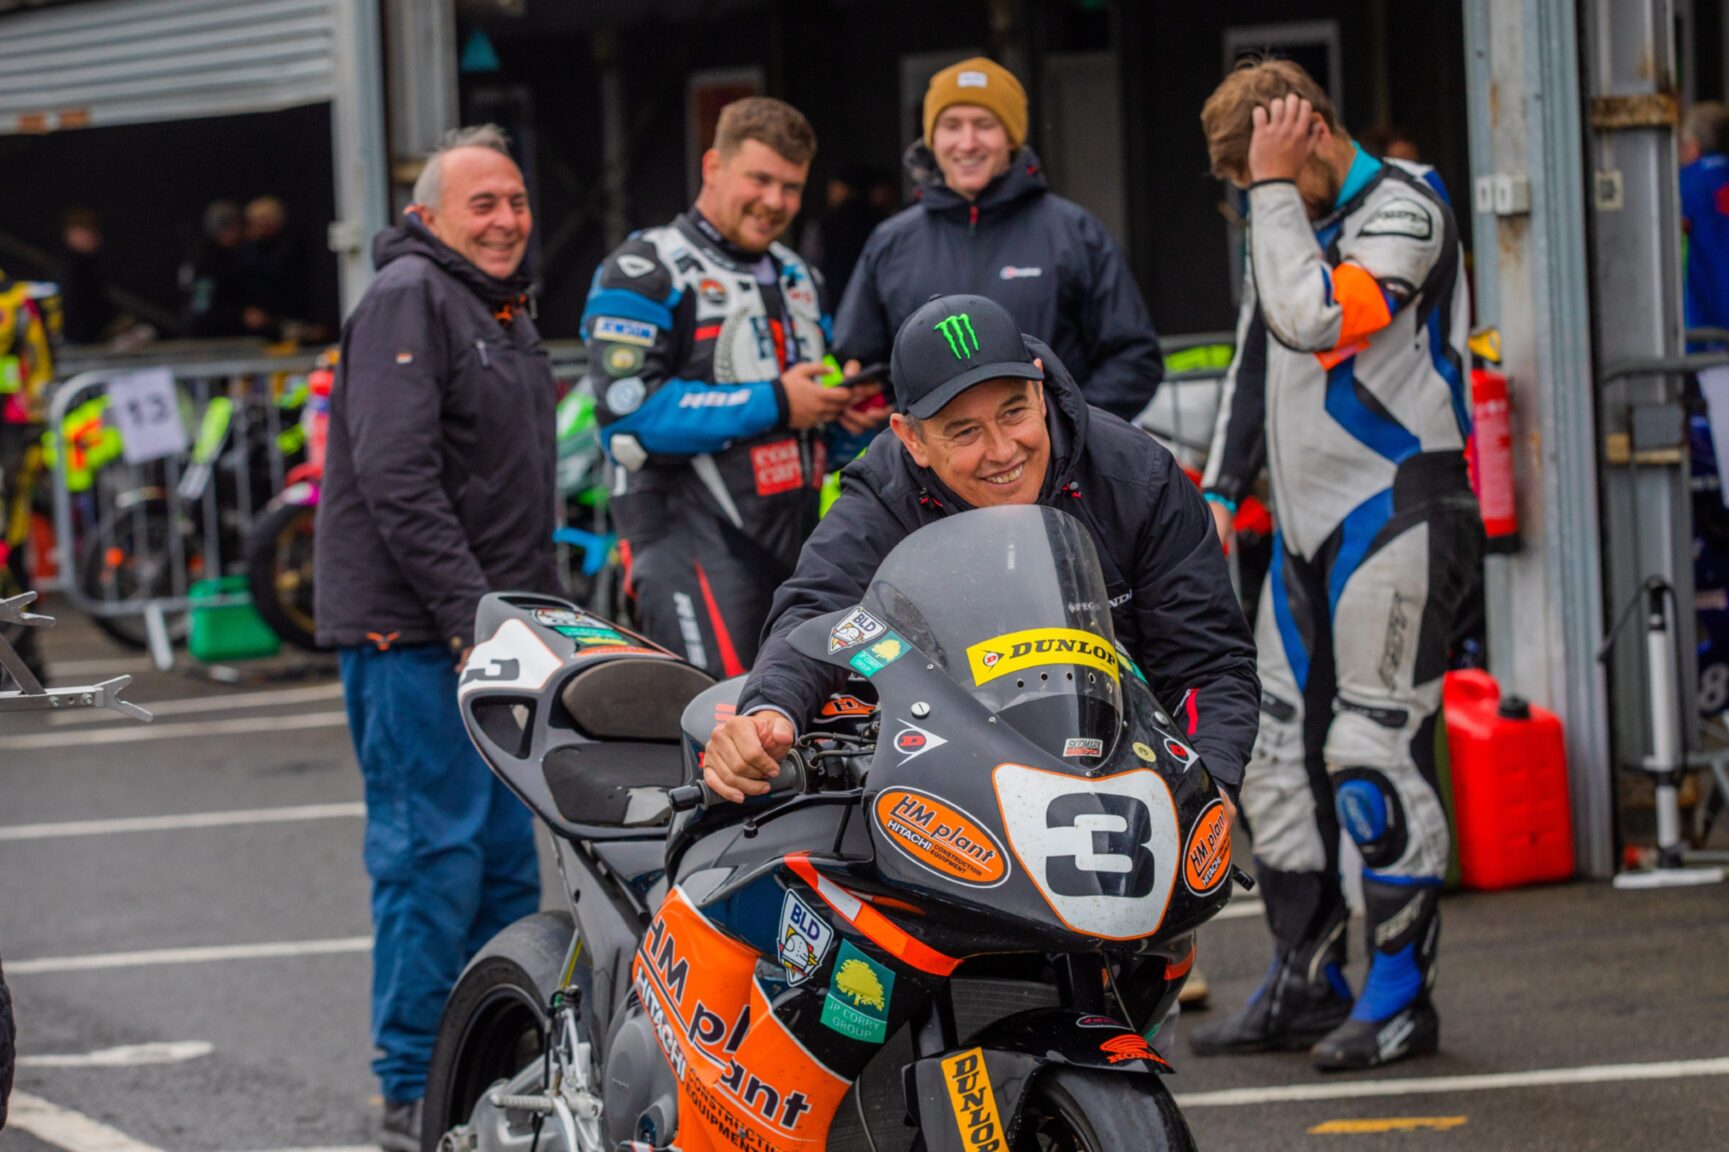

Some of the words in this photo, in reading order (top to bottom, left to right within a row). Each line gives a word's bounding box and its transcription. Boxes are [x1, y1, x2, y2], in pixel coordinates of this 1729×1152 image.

[852, 612, 876, 632] BLD
[1009, 639, 1116, 666] DUNLOP
[887, 819, 933, 851] HITACHI
[889, 794, 937, 828] HM
[929, 823, 996, 864] plant
[1045, 791, 1155, 898] 3
[930, 849, 967, 875] EQUIPMENT
[934, 844, 983, 877] CONSTRUCTION
[1189, 838, 1209, 878] HM
[790, 902, 820, 941] BLD
[636, 964, 688, 1084] HITACHI
[640, 915, 690, 1005] HM
[687, 1000, 810, 1131] plant
[827, 1001, 841, 1013] JP
[843, 1008, 881, 1031] CORRY
[832, 1016, 872, 1038] GROUP
[689, 1067, 780, 1152] CONSTRUCTI
[952, 1054, 1000, 1152] DUNLOP
